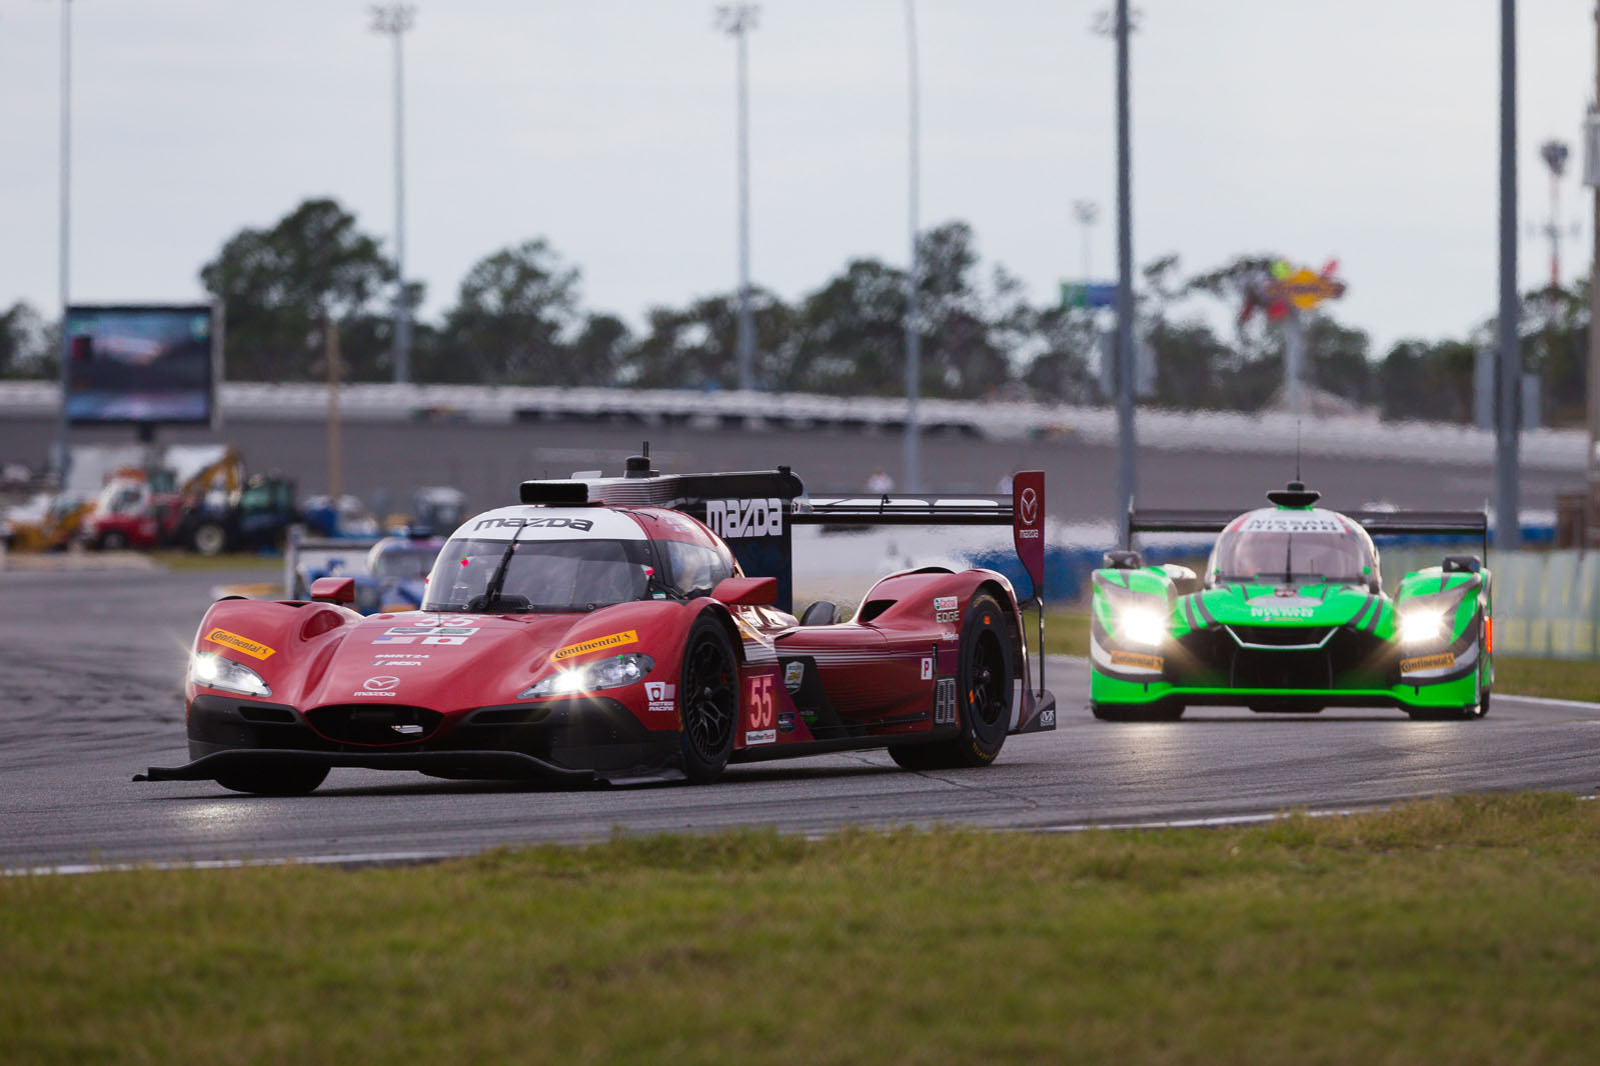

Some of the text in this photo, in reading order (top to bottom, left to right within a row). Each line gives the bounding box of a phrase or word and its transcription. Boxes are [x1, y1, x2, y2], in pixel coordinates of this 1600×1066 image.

[936, 611, 960, 623] EDGE
[210, 629, 262, 654] Continental
[554, 634, 622, 660] Continental
[1401, 655, 1447, 673] Continental
[750, 677, 772, 728] 55
